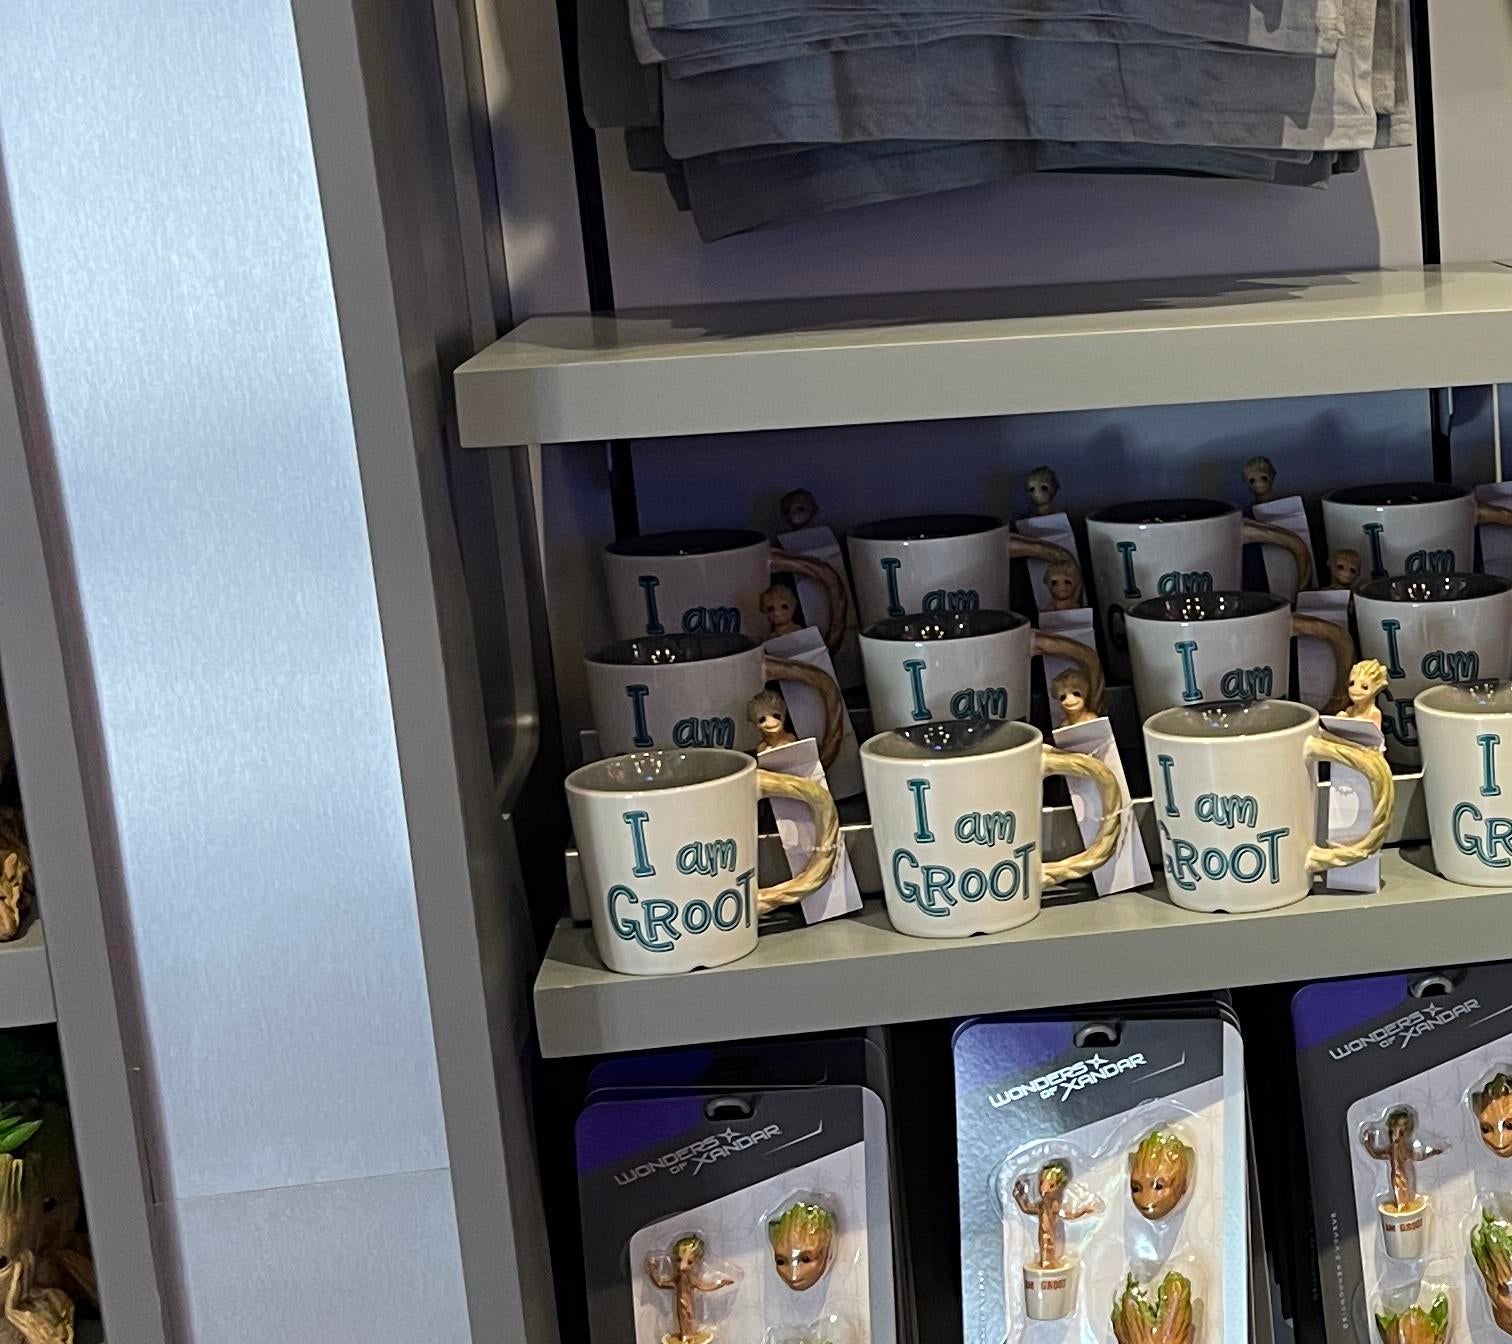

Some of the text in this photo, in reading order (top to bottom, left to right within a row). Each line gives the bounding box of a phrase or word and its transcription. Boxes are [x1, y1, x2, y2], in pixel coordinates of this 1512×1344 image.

[1117, 541, 1213, 599] I am
[1363, 523, 1456, 579] I am
[638, 576, 741, 634] I am
[880, 557, 979, 617] I am
[1175, 641, 1272, 702] I am
[1382, 619, 1480, 682] I am
[626, 685, 735, 750] I am
[903, 659, 1007, 721] I am
[1158, 754, 1258, 828] I am
[1476, 734, 1500, 796] I
[907, 778, 1016, 847] I am
[623, 811, 738, 878] I am
[892, 843, 1036, 917] GROOT
[607, 869, 755, 952] GROOT
[1328, 1010, 1425, 1060] WONDERS
[1400, 998, 1481, 1049] XANDAR
[987, 1061, 1087, 1108] WONDERS
[1060, 1053, 1148, 1101] XANDAR
[614, 1135, 719, 1186] WONDERS
[692, 1124, 783, 1176] XANDAR
